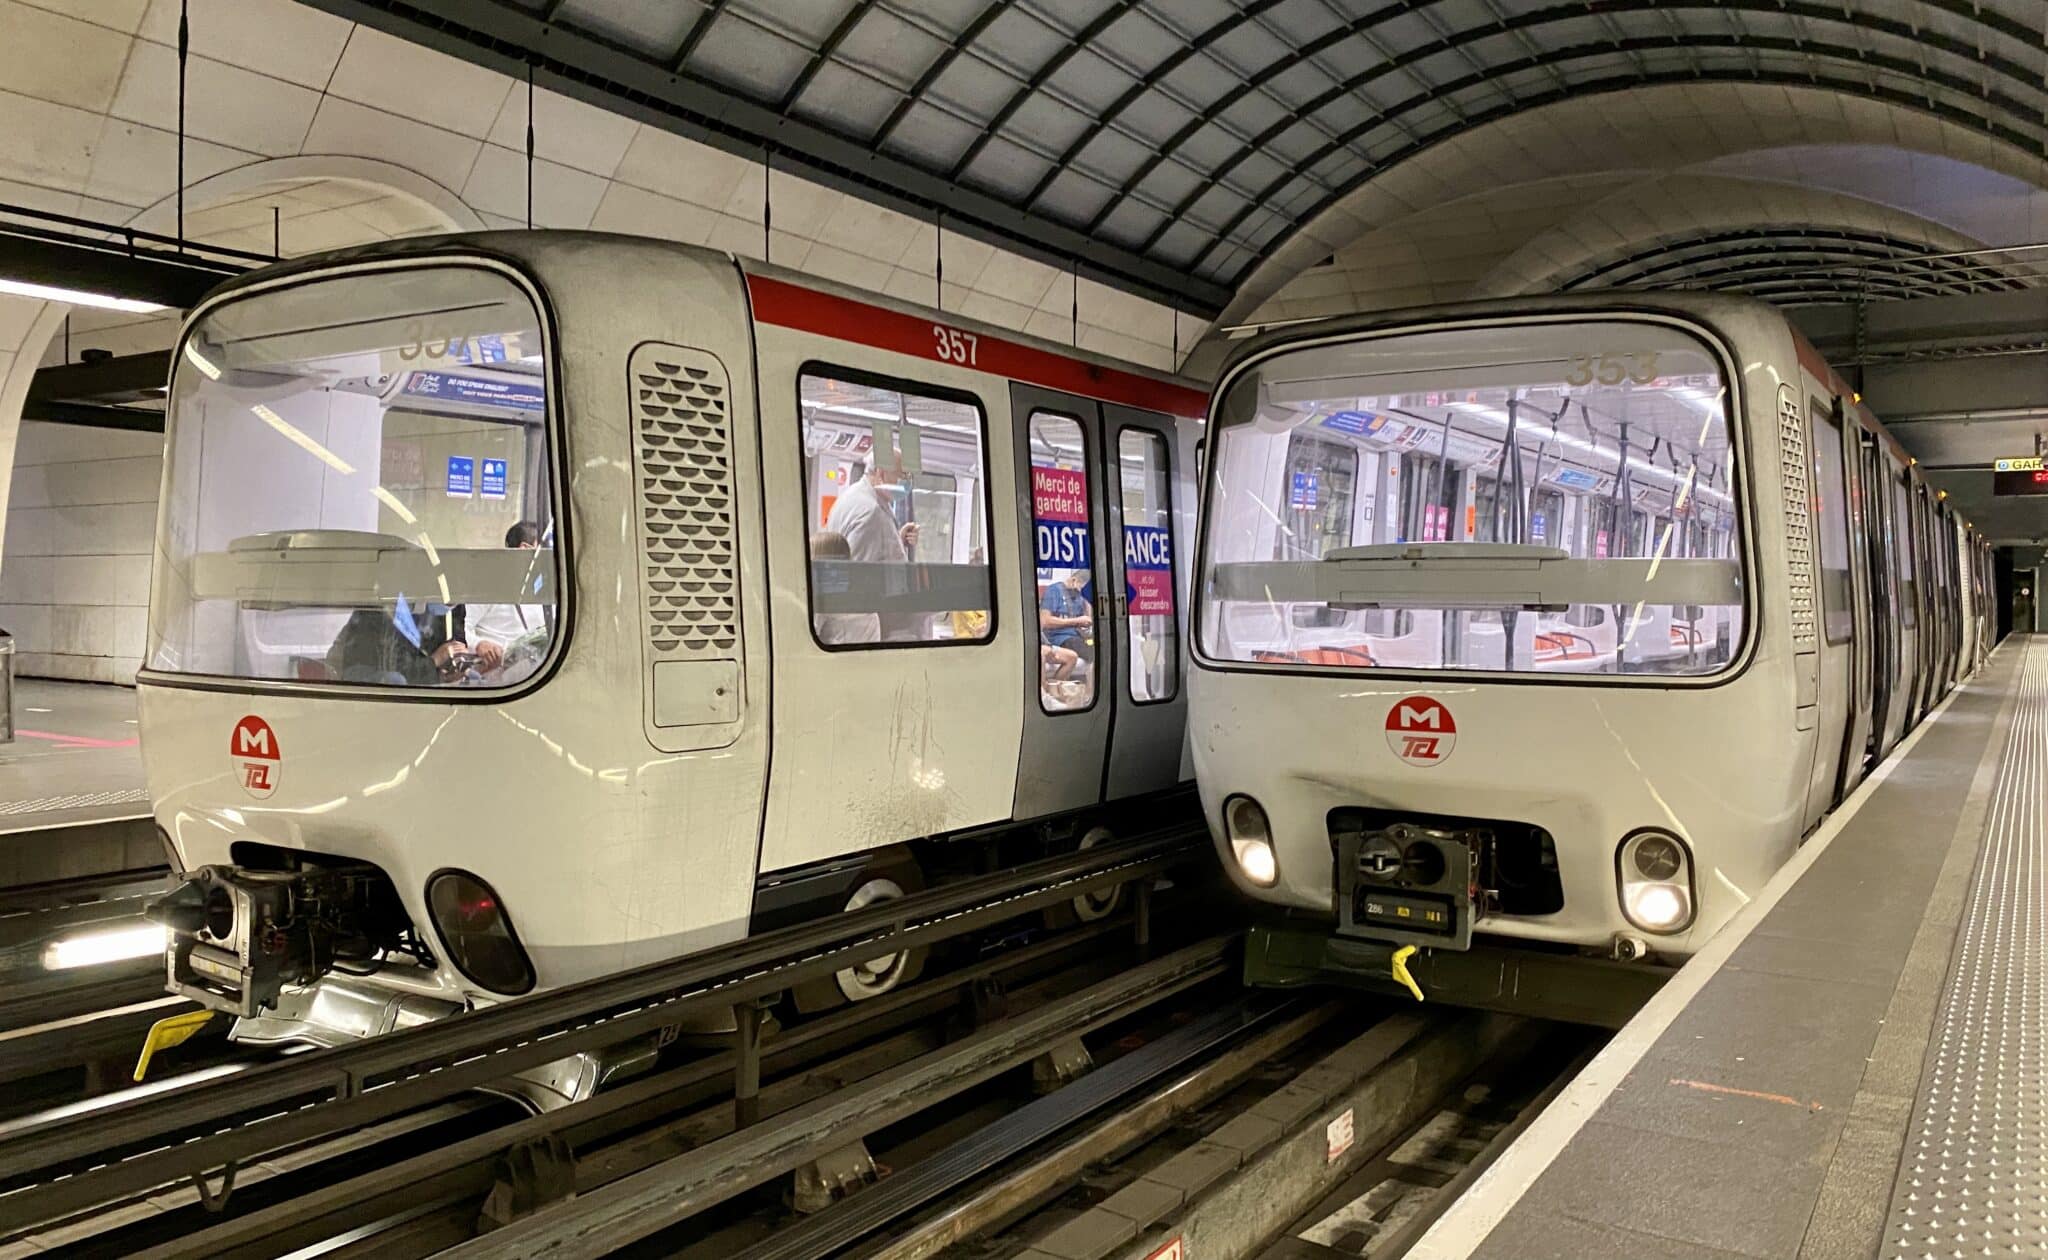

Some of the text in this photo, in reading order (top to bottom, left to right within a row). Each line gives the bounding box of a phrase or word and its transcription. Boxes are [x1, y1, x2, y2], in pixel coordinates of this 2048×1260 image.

[933, 325, 977, 366] 357
[1566, 351, 1658, 386] 353
[1035, 471, 1080, 495] Merci de
[1036, 494, 1084, 515] garder la
[1037, 525, 1087, 563] DIST
[1125, 530, 1170, 565] ANCE
[1400, 705, 1440, 729] M
[240, 726, 269, 755] M
[1402, 735, 1440, 759] TCL
[243, 762, 272, 790] TCL
